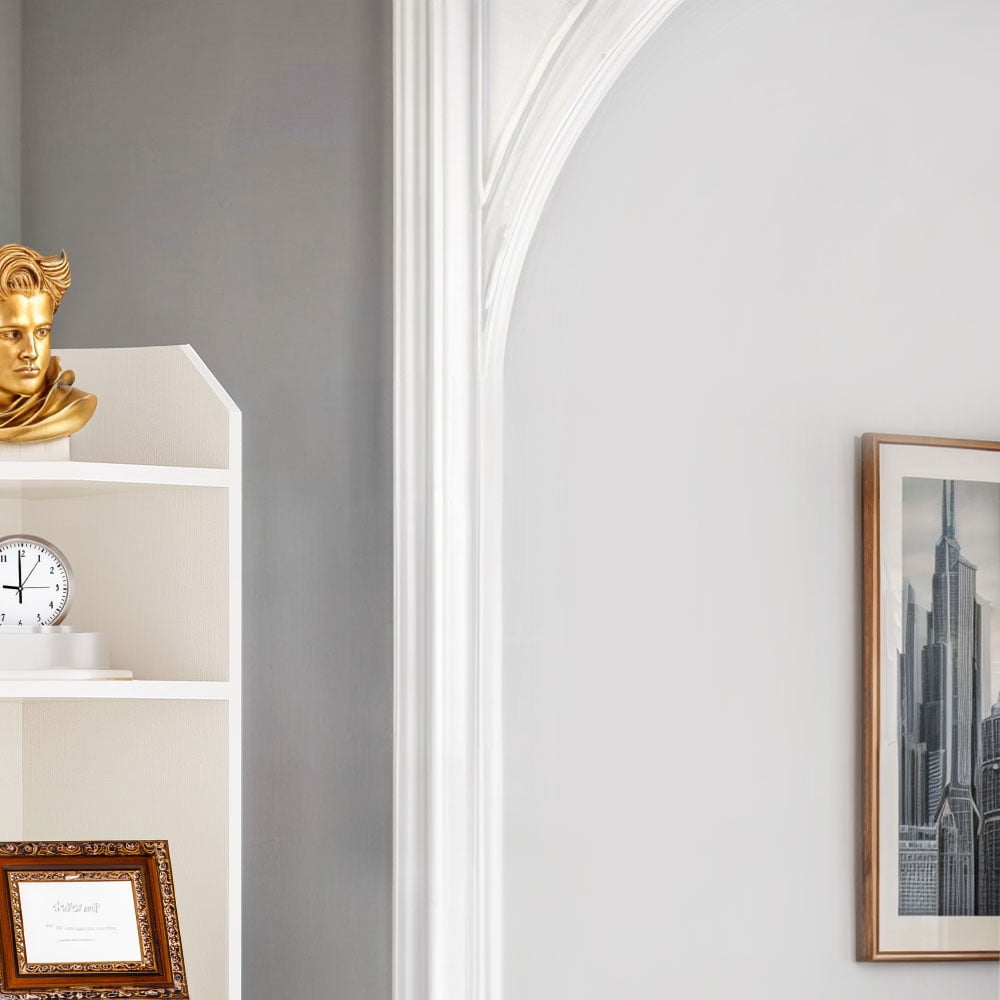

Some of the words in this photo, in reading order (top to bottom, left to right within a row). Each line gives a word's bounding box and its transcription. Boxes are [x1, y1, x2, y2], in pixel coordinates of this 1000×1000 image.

[49, 601, 54, 609] 4
[1, 613, 6, 621] 7
[36, 613, 41, 622] 5
